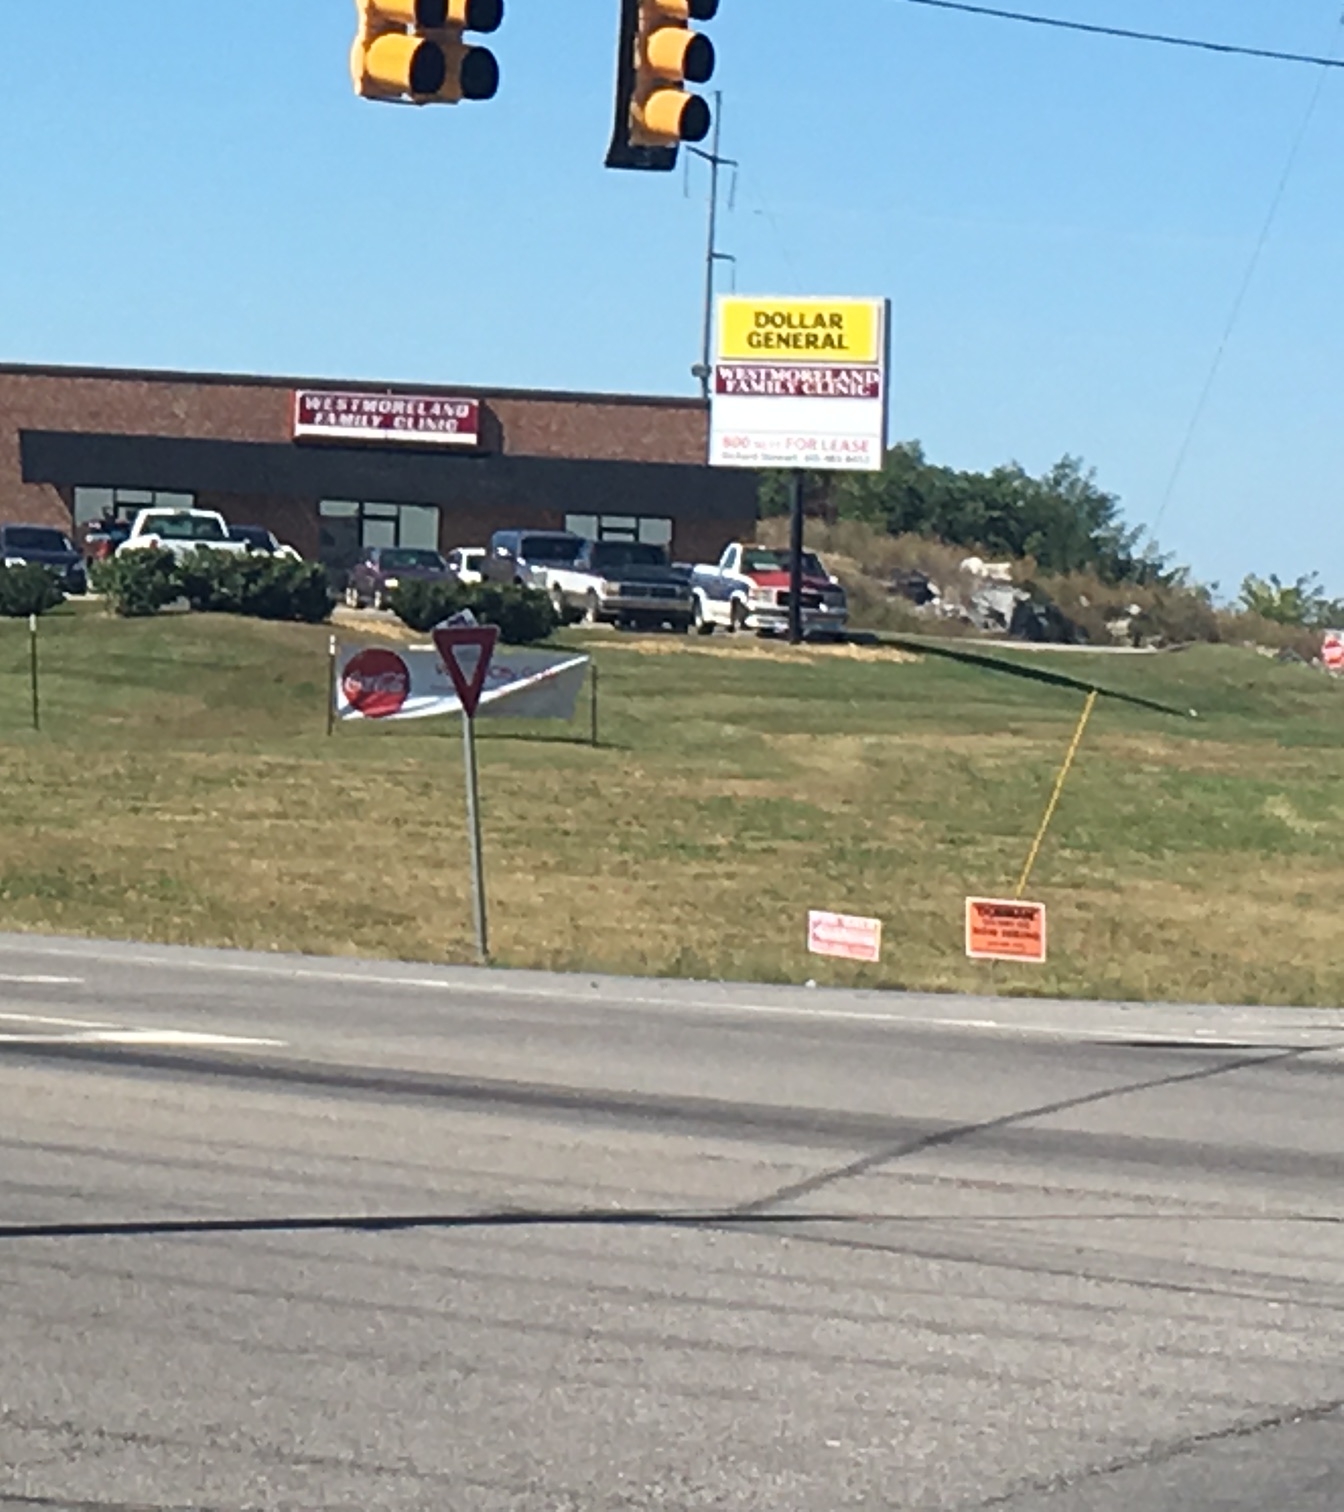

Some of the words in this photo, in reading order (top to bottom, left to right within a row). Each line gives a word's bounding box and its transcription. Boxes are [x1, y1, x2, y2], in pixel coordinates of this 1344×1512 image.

[753, 311, 843, 330] DOLLAR
[746, 331, 850, 350] GENERAL
[719, 366, 881, 384] WESTMORELAND
[725, 379, 798, 393] FAMILY
[801, 381, 872, 396] CLINIC
[305, 396, 470, 418] WESTMORELAND
[314, 413, 383, 427] FAMILY
[393, 415, 459, 432] CLINIC
[784, 437, 818, 452] FOR
[821, 438, 869, 453] LEASE
